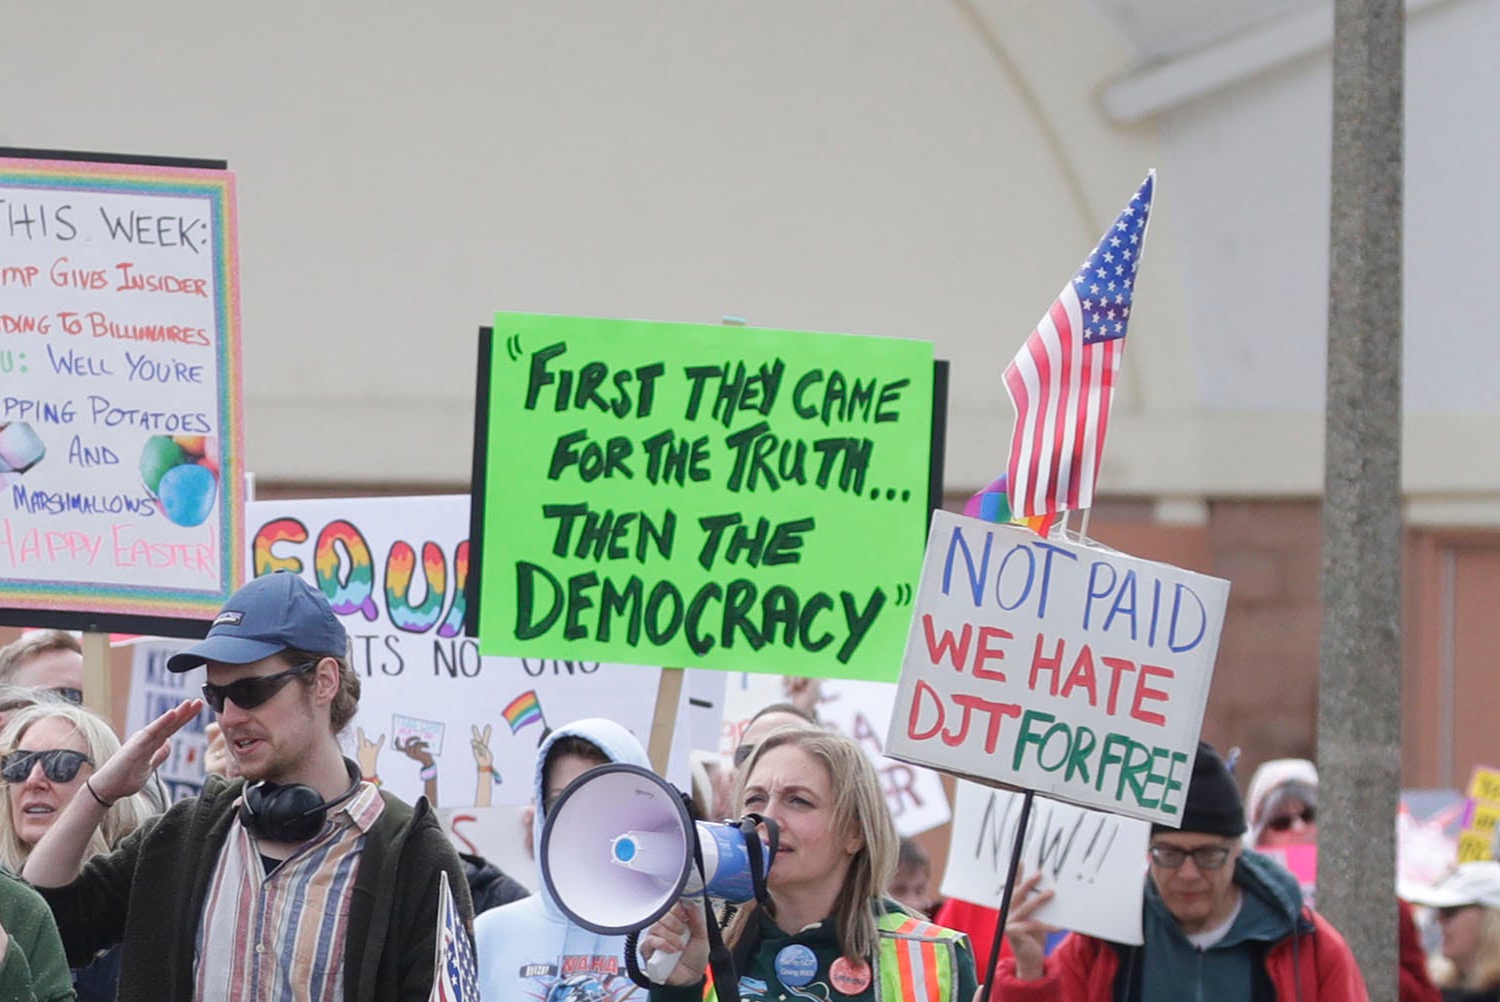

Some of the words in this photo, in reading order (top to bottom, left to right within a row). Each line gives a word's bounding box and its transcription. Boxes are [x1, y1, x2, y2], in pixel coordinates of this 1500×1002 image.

[100, 206, 207, 254] WEEK:
[115, 262, 208, 298] INSIDER
[47, 343, 114, 376] WELL
[87, 395, 212, 433] POTATOES
[683, 357, 786, 428] THEY
[792, 368, 911, 427] CAME
[68, 434, 120, 468] AND
[547, 428, 634, 482] FOR
[642, 428, 712, 488] THE
[725, 421, 911, 503] TRUTH...
[542, 501, 677, 565] THEN
[698, 512, 816, 572] THE
[941, 526, 1078, 619] NOT
[1082, 561, 1207, 653] PAID
[434, 639, 482, 678] NO
[922, 613, 1014, 682] WE
[1028, 632, 1175, 727] HATE
[907, 679, 1022, 755] DJT
[1012, 709, 1097, 784] FOR
[1095, 732, 1189, 814] FREE
